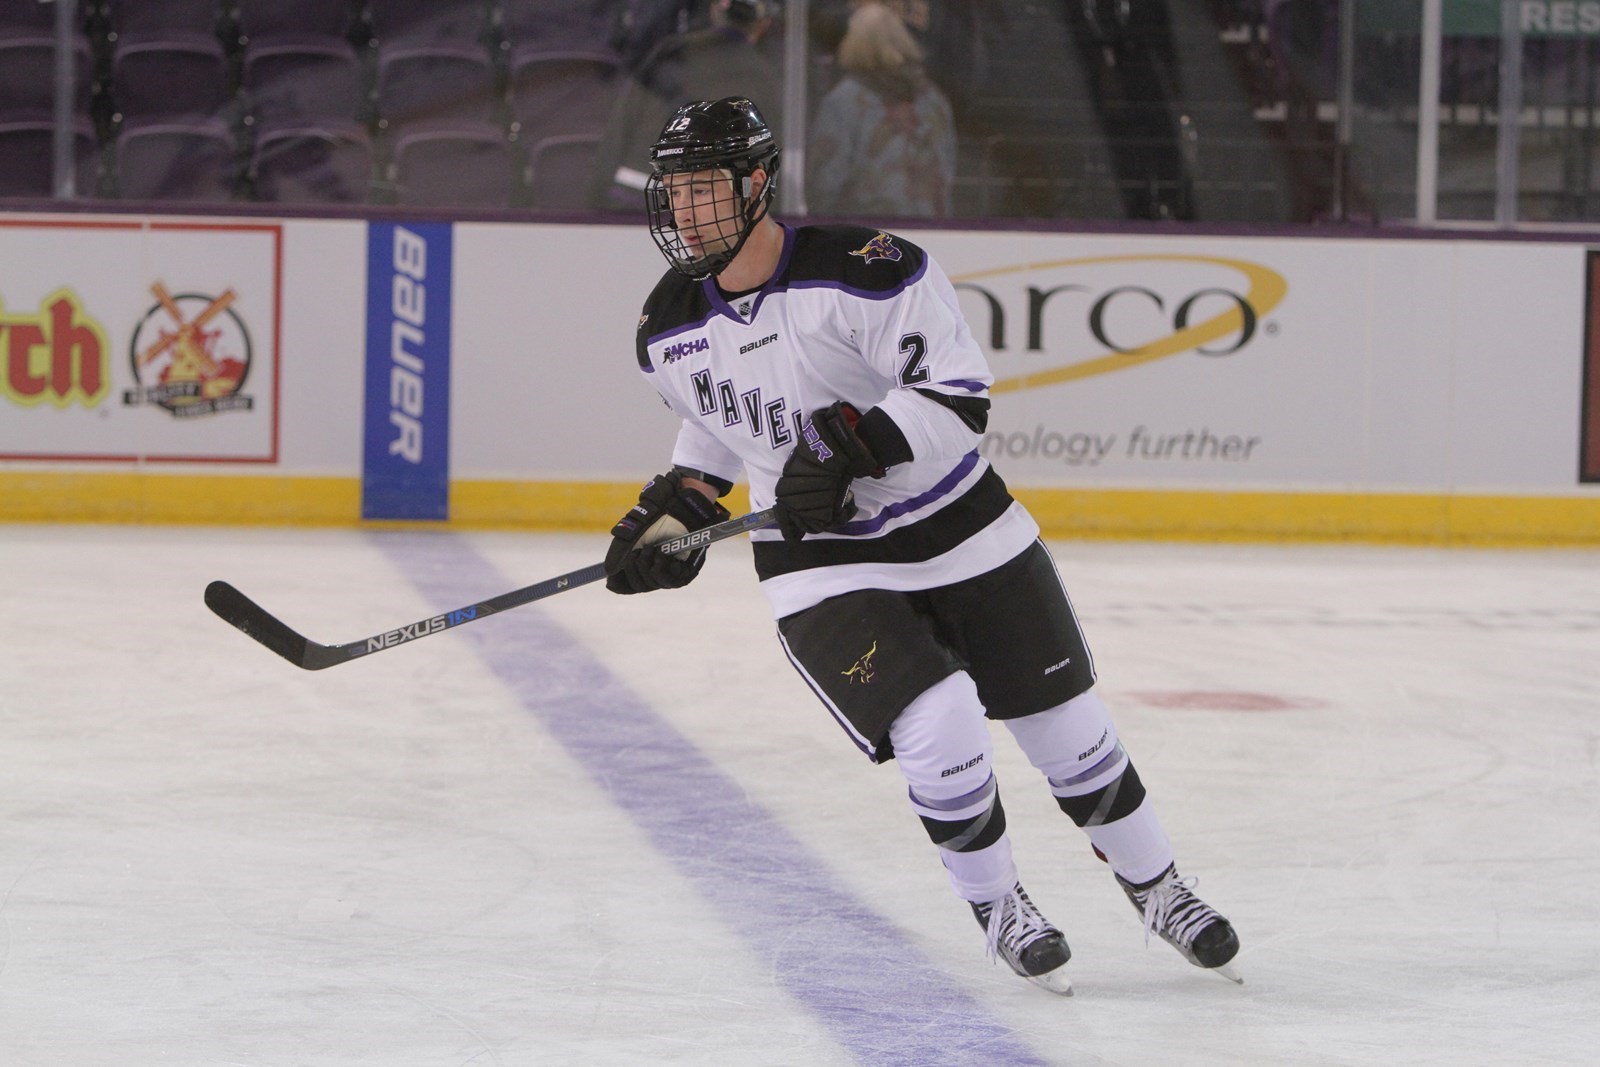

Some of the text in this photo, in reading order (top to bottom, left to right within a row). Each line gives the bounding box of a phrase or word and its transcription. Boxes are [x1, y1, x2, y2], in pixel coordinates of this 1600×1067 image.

[667, 117, 691, 131] 12
[664, 338, 709, 363] WCHA
[899, 332, 930, 388] 2
[1126, 424, 1261, 461] further
